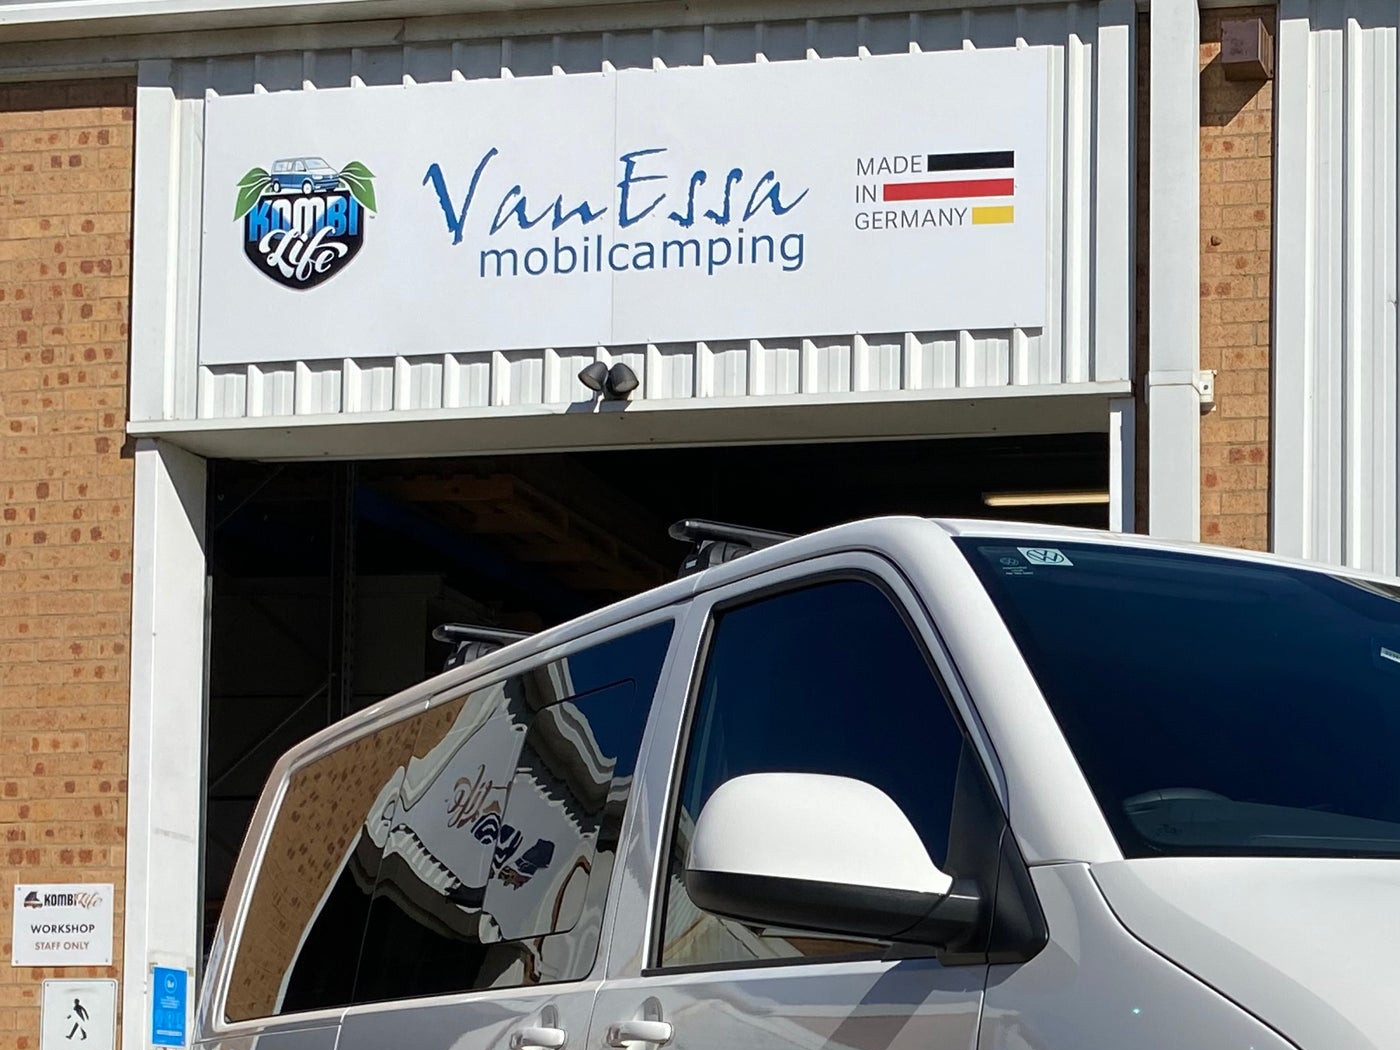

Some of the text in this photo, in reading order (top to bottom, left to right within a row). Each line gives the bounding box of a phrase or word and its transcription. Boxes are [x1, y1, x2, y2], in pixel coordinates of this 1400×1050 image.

[856, 154, 923, 176] MADE
[422, 147, 809, 246] VanEssa
[855, 184, 877, 203] IN
[249, 194, 359, 242] KOMBI
[854, 207, 968, 231] GERMANY
[258, 225, 349, 281] Life
[479, 227, 805, 278] mobilcamping
[44, 893, 77, 907] KOMBI
[30, 923, 95, 934] WORKSHOP
[34, 941, 90, 951] STAFF ONLY
